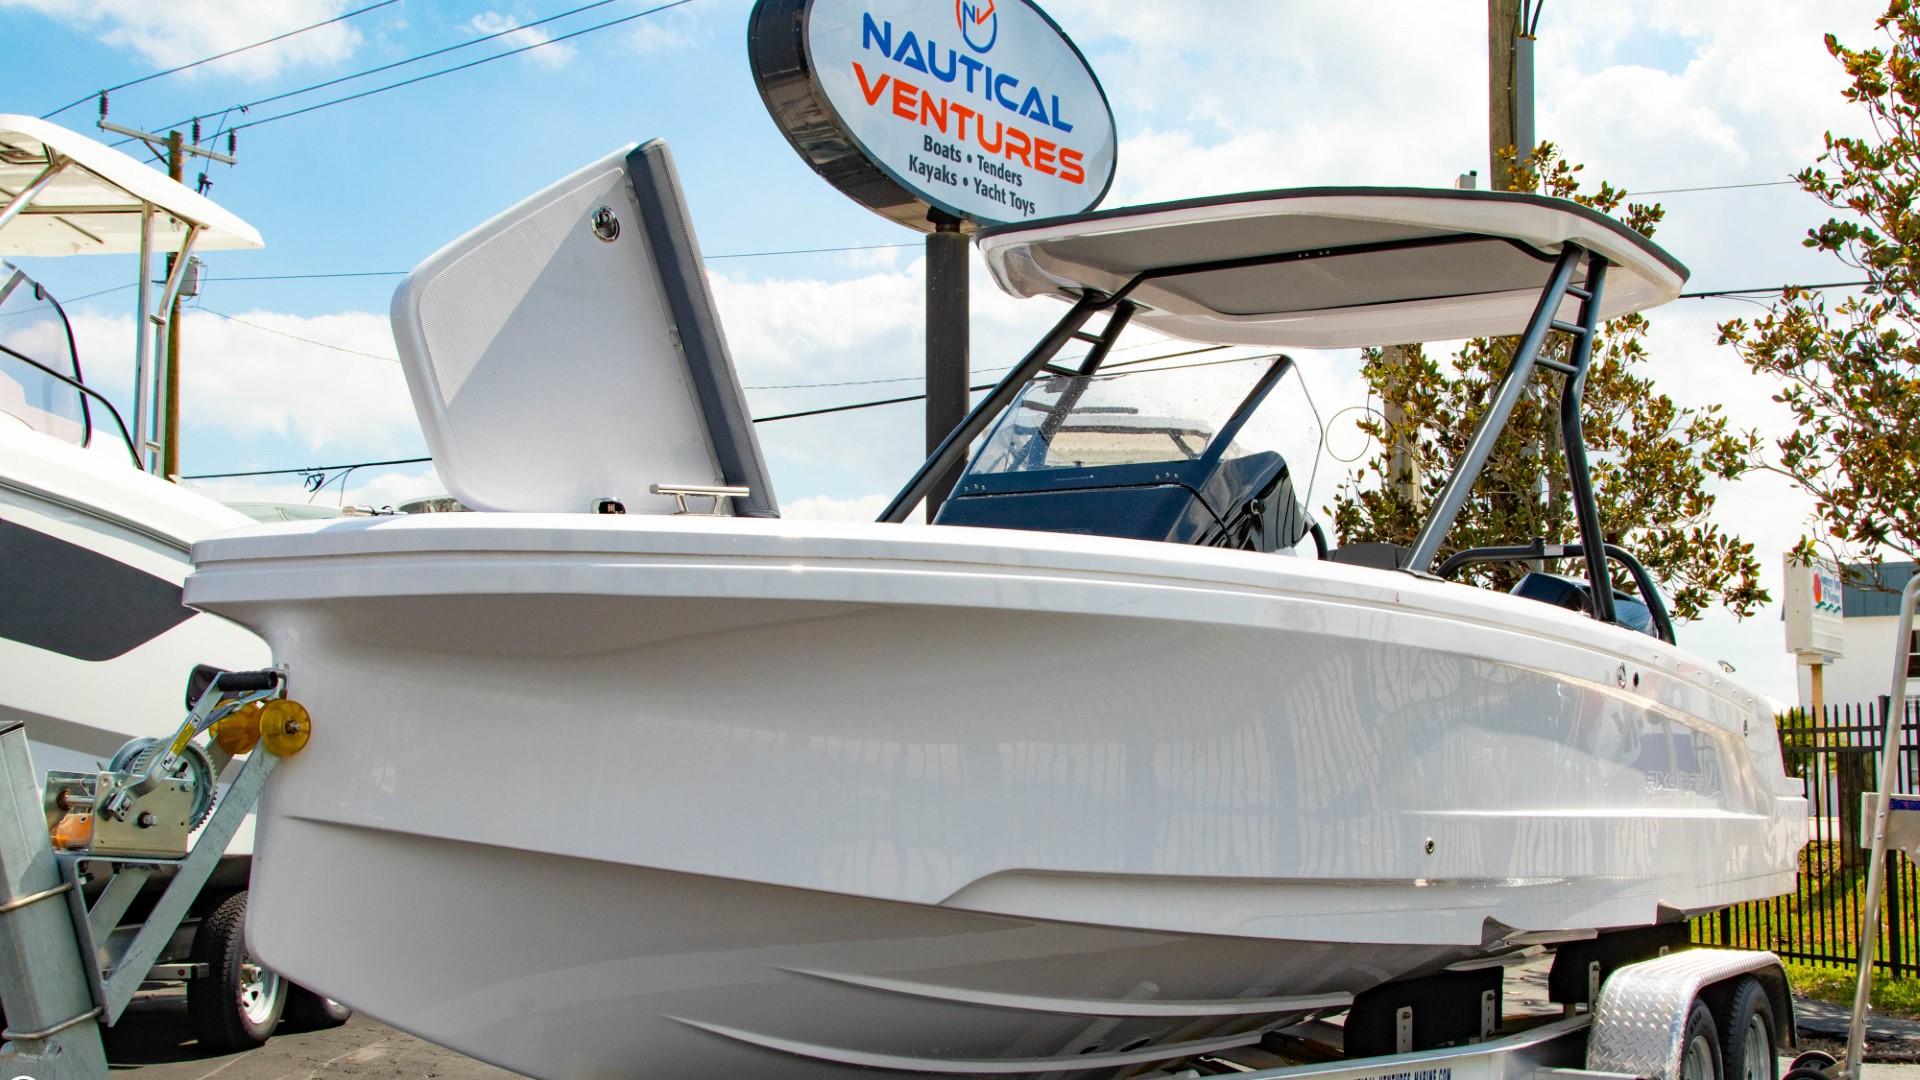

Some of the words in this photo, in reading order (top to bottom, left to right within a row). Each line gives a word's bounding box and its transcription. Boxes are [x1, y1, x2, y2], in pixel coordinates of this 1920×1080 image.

[862, 11, 1074, 133] NAUTICAL
[851, 61, 1086, 185] VENTURES
[923, 134, 962, 163] Boats
[976, 154, 1023, 187] Tenders
[908, 154, 958, 187] Kayaks
[973, 177, 1007, 205] Yacht
[1008, 191, 1036, 217] Toys
